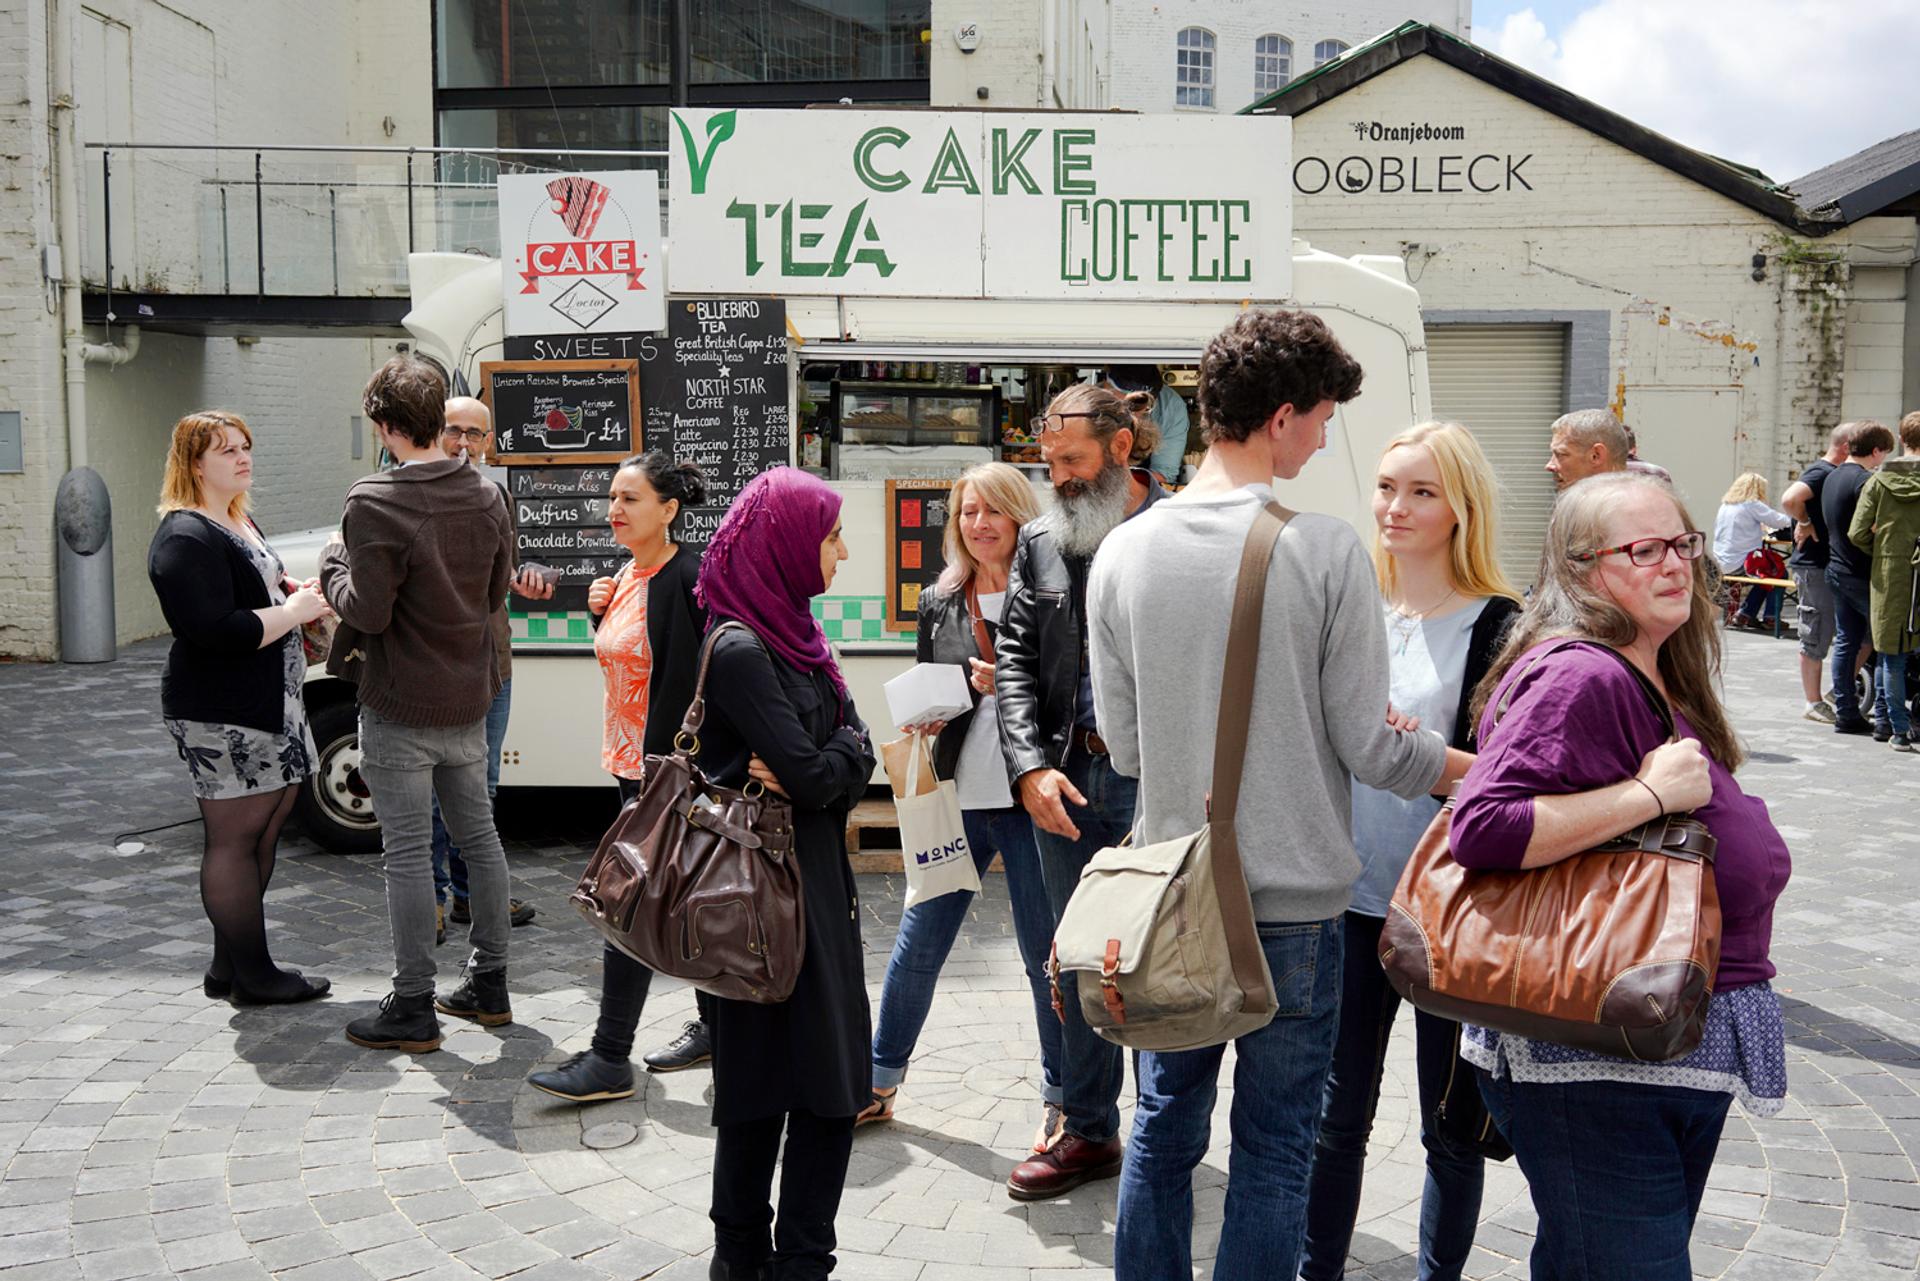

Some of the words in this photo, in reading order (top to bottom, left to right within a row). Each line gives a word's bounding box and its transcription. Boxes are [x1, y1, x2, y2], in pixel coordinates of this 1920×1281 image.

[1369, 122, 1465, 144] Oranjeboom
[853, 126, 1097, 195] CAKE
[1293, 154, 1534, 194] OOBLECK
[726, 197, 898, 277] TEA
[1061, 199, 1252, 286] COFFEE
[532, 242, 631, 273] CAKE
[696, 301, 760, 320] BLUEBIRD
[698, 321, 727, 334] TEA
[532, 336, 658, 361] SWEETS
[674, 335, 703, 349] Great
[705, 334, 737, 349] British
[738, 333, 764, 354] Cuppa
[674, 350, 722, 366] Speciality
[722, 349, 744, 362] Teas
[562, 374, 596, 386] Brownie
[597, 373, 629, 388] Special
[686, 379, 730, 396] NORTH
[733, 377, 767, 395] STAR
[686, 397, 724, 410] COFFEE
[733, 405, 749, 417] REG
[763, 404, 787, 415] LARGE
[598, 417, 627, 441] £4
[673, 413, 721, 428] Americano
[732, 416, 747, 426] £2
[498, 437, 514, 451] VE
[674, 429, 702, 441] Latte
[673, 440, 729, 457] Cappuccino
[696, 451, 722, 465] white
[518, 474, 576, 494] Meringue
[577, 476, 600, 493] Kiss
[597, 470, 611, 480] VE
[519, 503, 579, 526] Duffins
[584, 498, 600, 513] VE
[518, 533, 574, 549] Chocolate
[576, 530, 617, 549] Brownie
[565, 563, 598, 576] Cookie
[602, 559, 615, 569] VE
